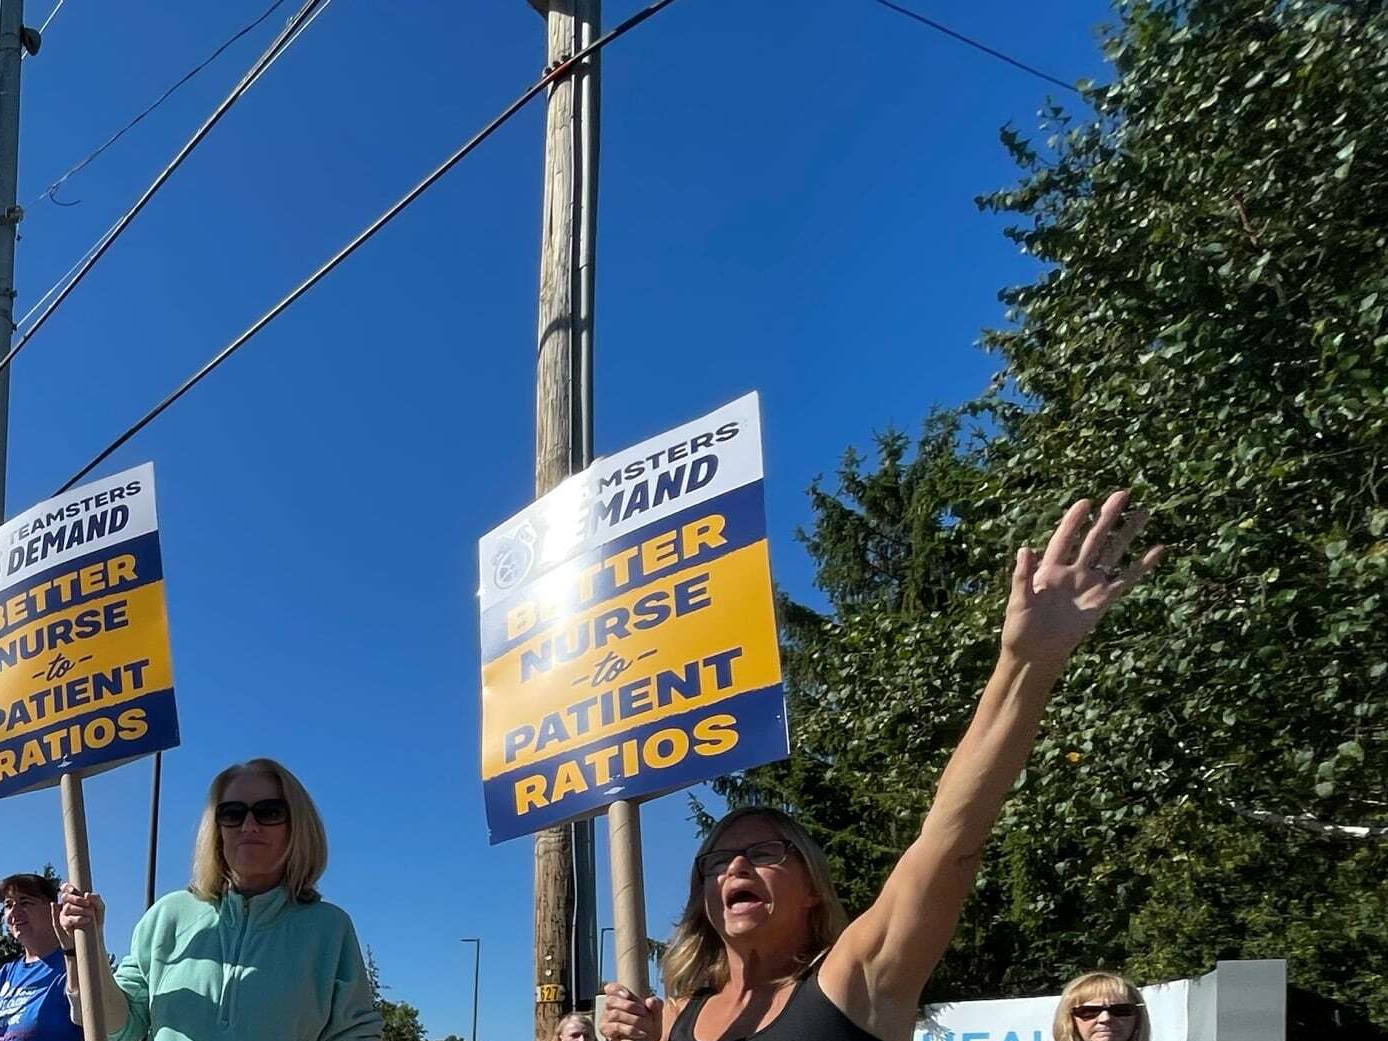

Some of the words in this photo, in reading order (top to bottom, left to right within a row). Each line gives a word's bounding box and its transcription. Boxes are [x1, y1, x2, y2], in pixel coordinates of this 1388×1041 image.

[6, 504, 130, 576] DEMAND
[8, 480, 142, 545] TEAMSTERS
[520, 572, 713, 684] NURSE
[504, 646, 744, 764] PATIENT
[514, 713, 741, 817] RATIOS
